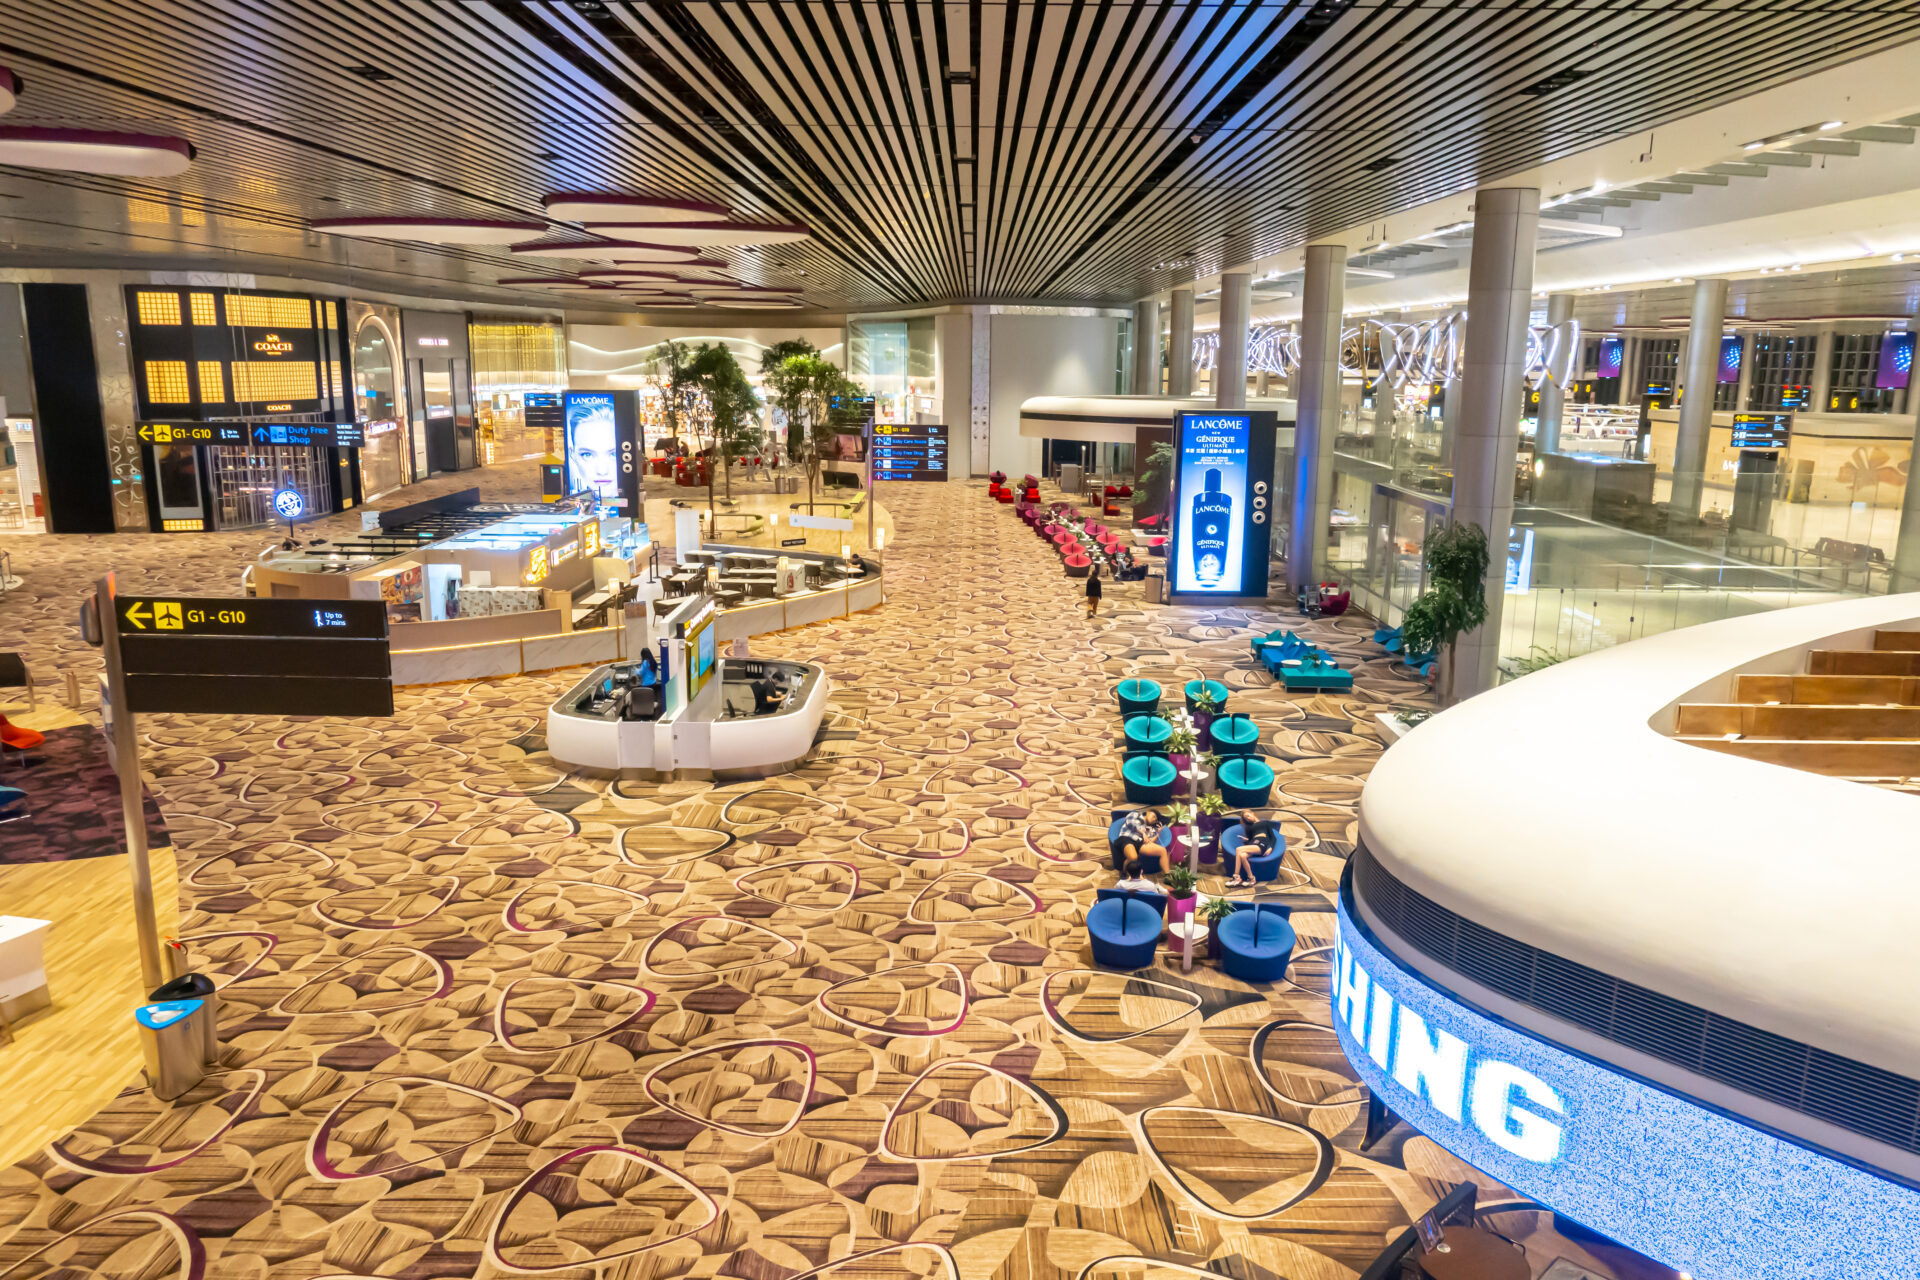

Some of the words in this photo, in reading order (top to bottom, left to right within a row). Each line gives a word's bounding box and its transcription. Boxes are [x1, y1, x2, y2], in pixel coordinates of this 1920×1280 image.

[254, 342, 293, 351] COACH
[571, 396, 609, 405] LANCÔME
[1531, 392, 1540, 403] 6
[1191, 419, 1243, 430] LANCÔME
[173, 429, 186, 438] G1
[192, 429, 212, 439] G10
[288, 426, 308, 436] Duty
[310, 426, 328, 434] Free
[288, 436, 310, 445] Shop
[1196, 435, 1236, 445] GÉNIFIQUE
[187, 610, 205, 623] G1
[218, 610, 246, 623] G10
